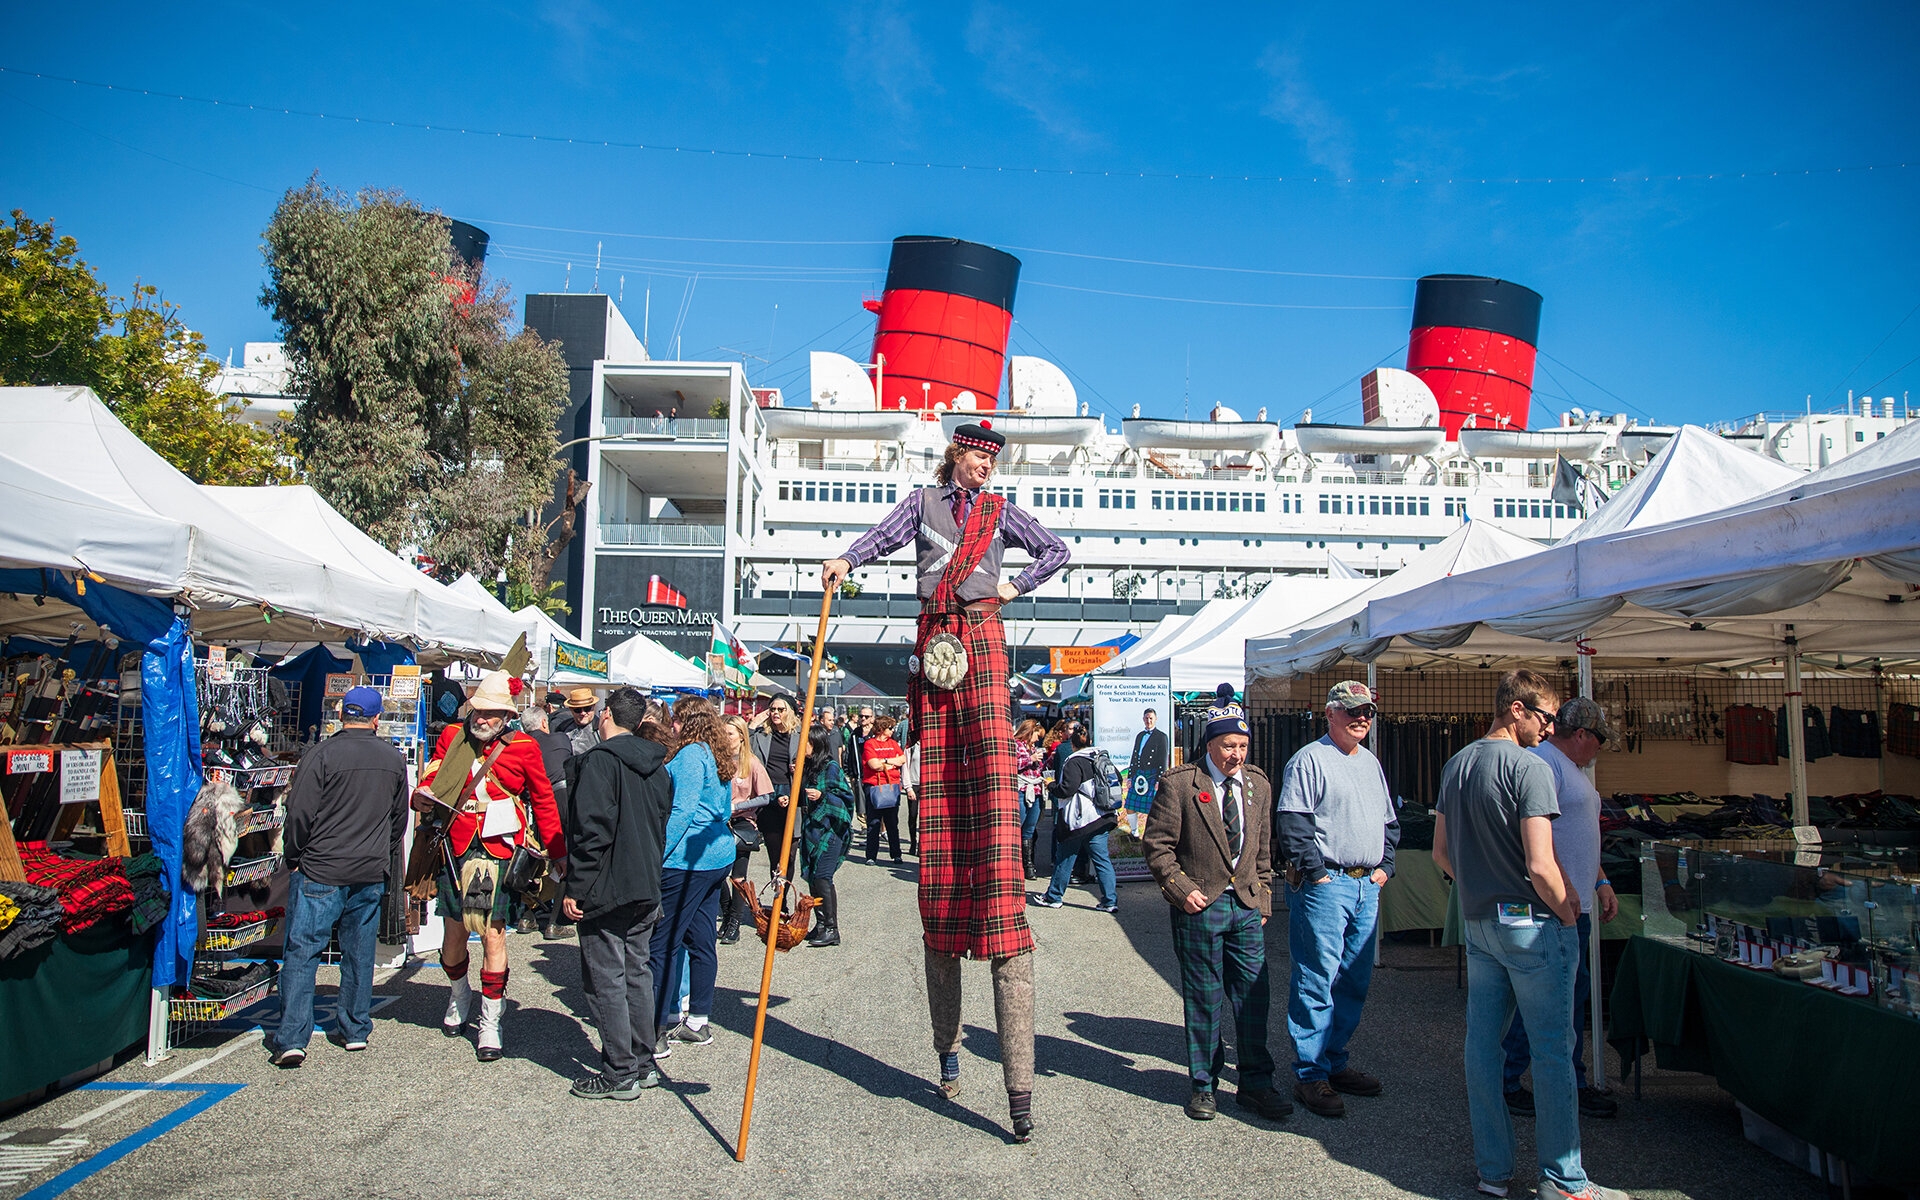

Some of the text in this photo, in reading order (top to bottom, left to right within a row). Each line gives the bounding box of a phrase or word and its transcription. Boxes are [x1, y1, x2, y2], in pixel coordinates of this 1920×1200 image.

[598, 607, 718, 627] THE QUEEN MARY
[1068, 656, 1102, 665] Originals
